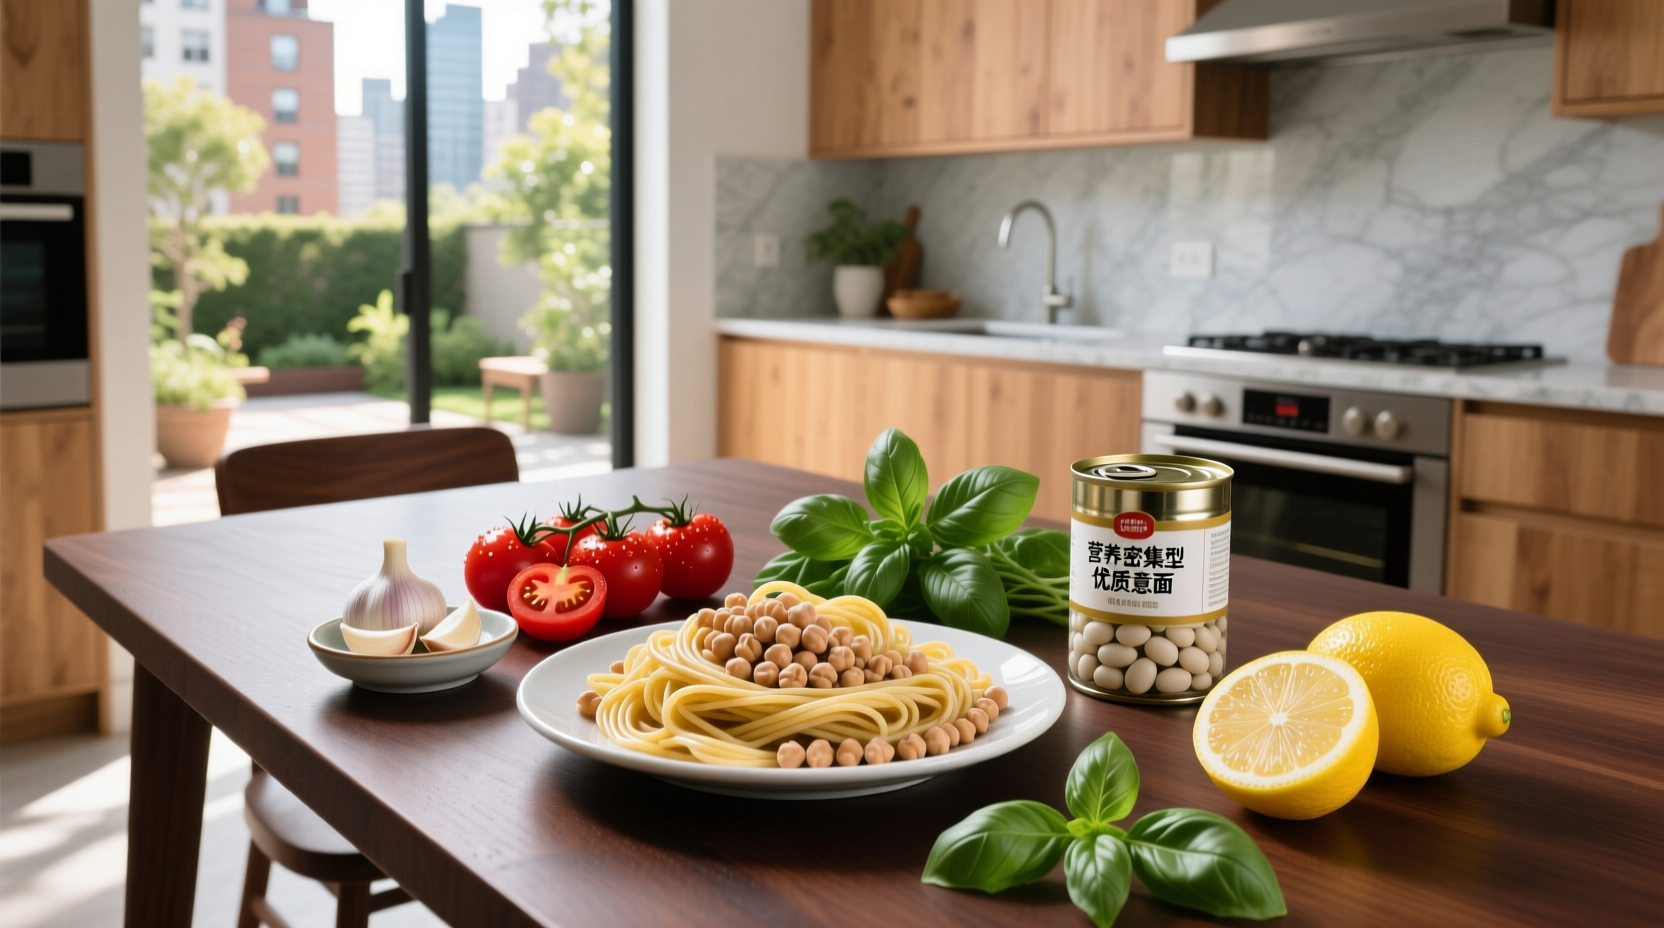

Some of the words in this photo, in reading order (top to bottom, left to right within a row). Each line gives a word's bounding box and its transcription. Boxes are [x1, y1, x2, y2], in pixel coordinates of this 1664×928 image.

[1088, 541, 1184, 569] 营养密集型
[1092, 566, 1174, 594] 优质意面
